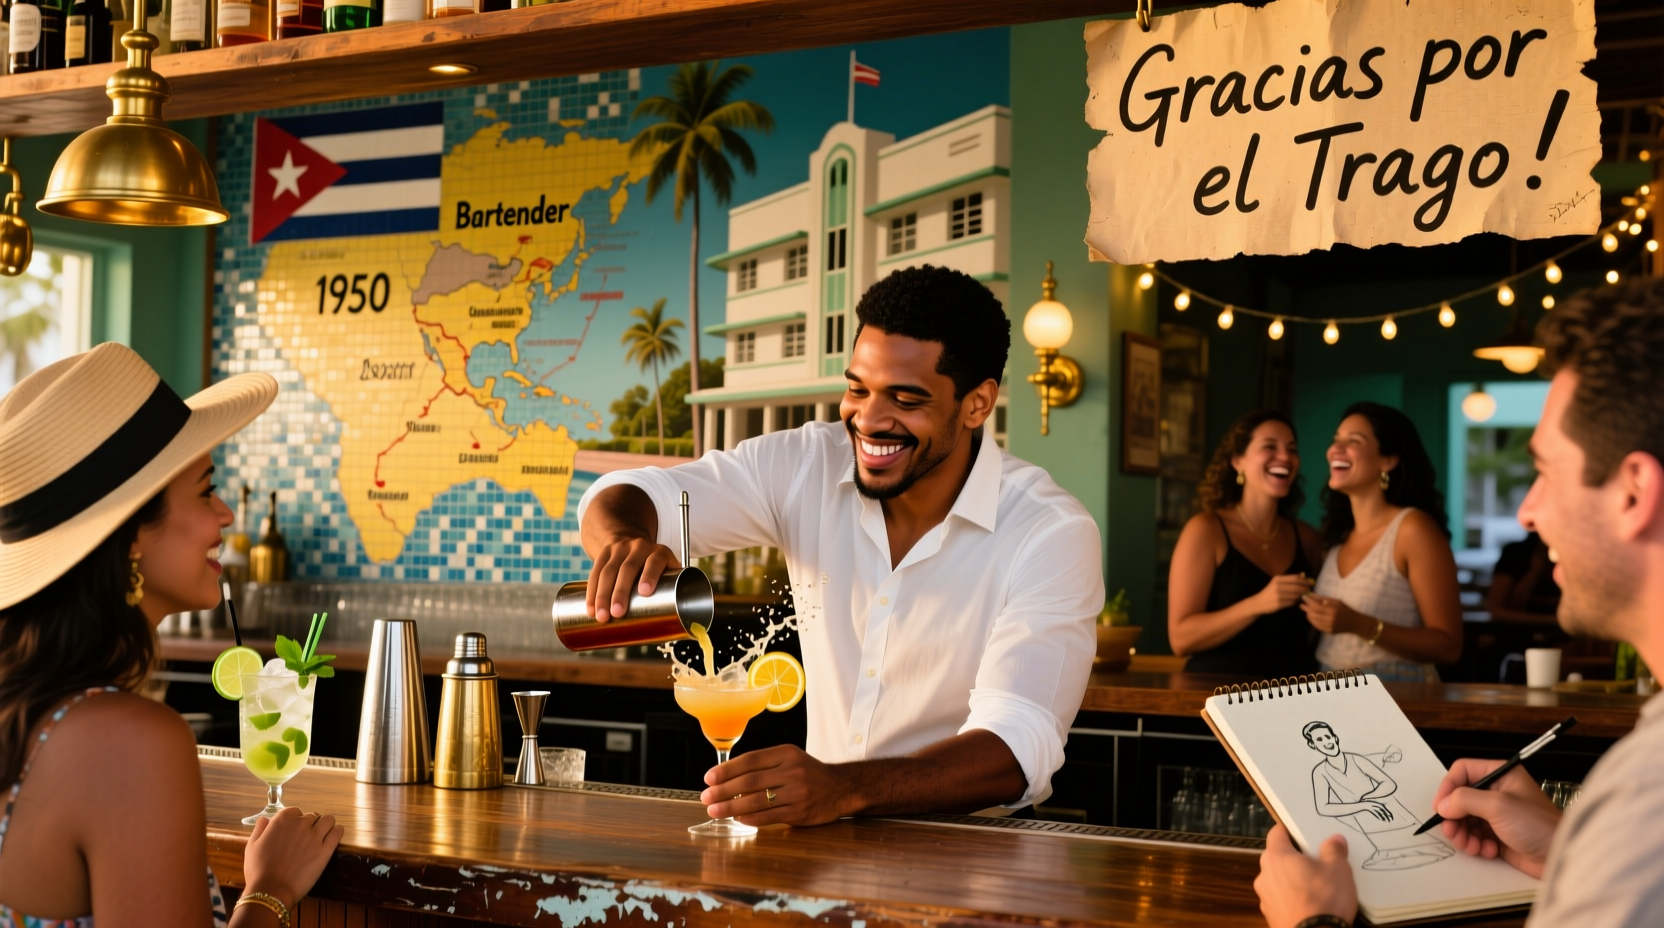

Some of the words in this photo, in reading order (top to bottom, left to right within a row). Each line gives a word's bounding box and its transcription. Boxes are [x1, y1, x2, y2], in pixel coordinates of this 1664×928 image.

[1119, 43, 1386, 148] Gracias
[1409, 28, 1548, 123] por
[1193, 132, 1261, 216] el
[455, 194, 570, 230] Bartender
[316, 271, 391, 315] 1950
